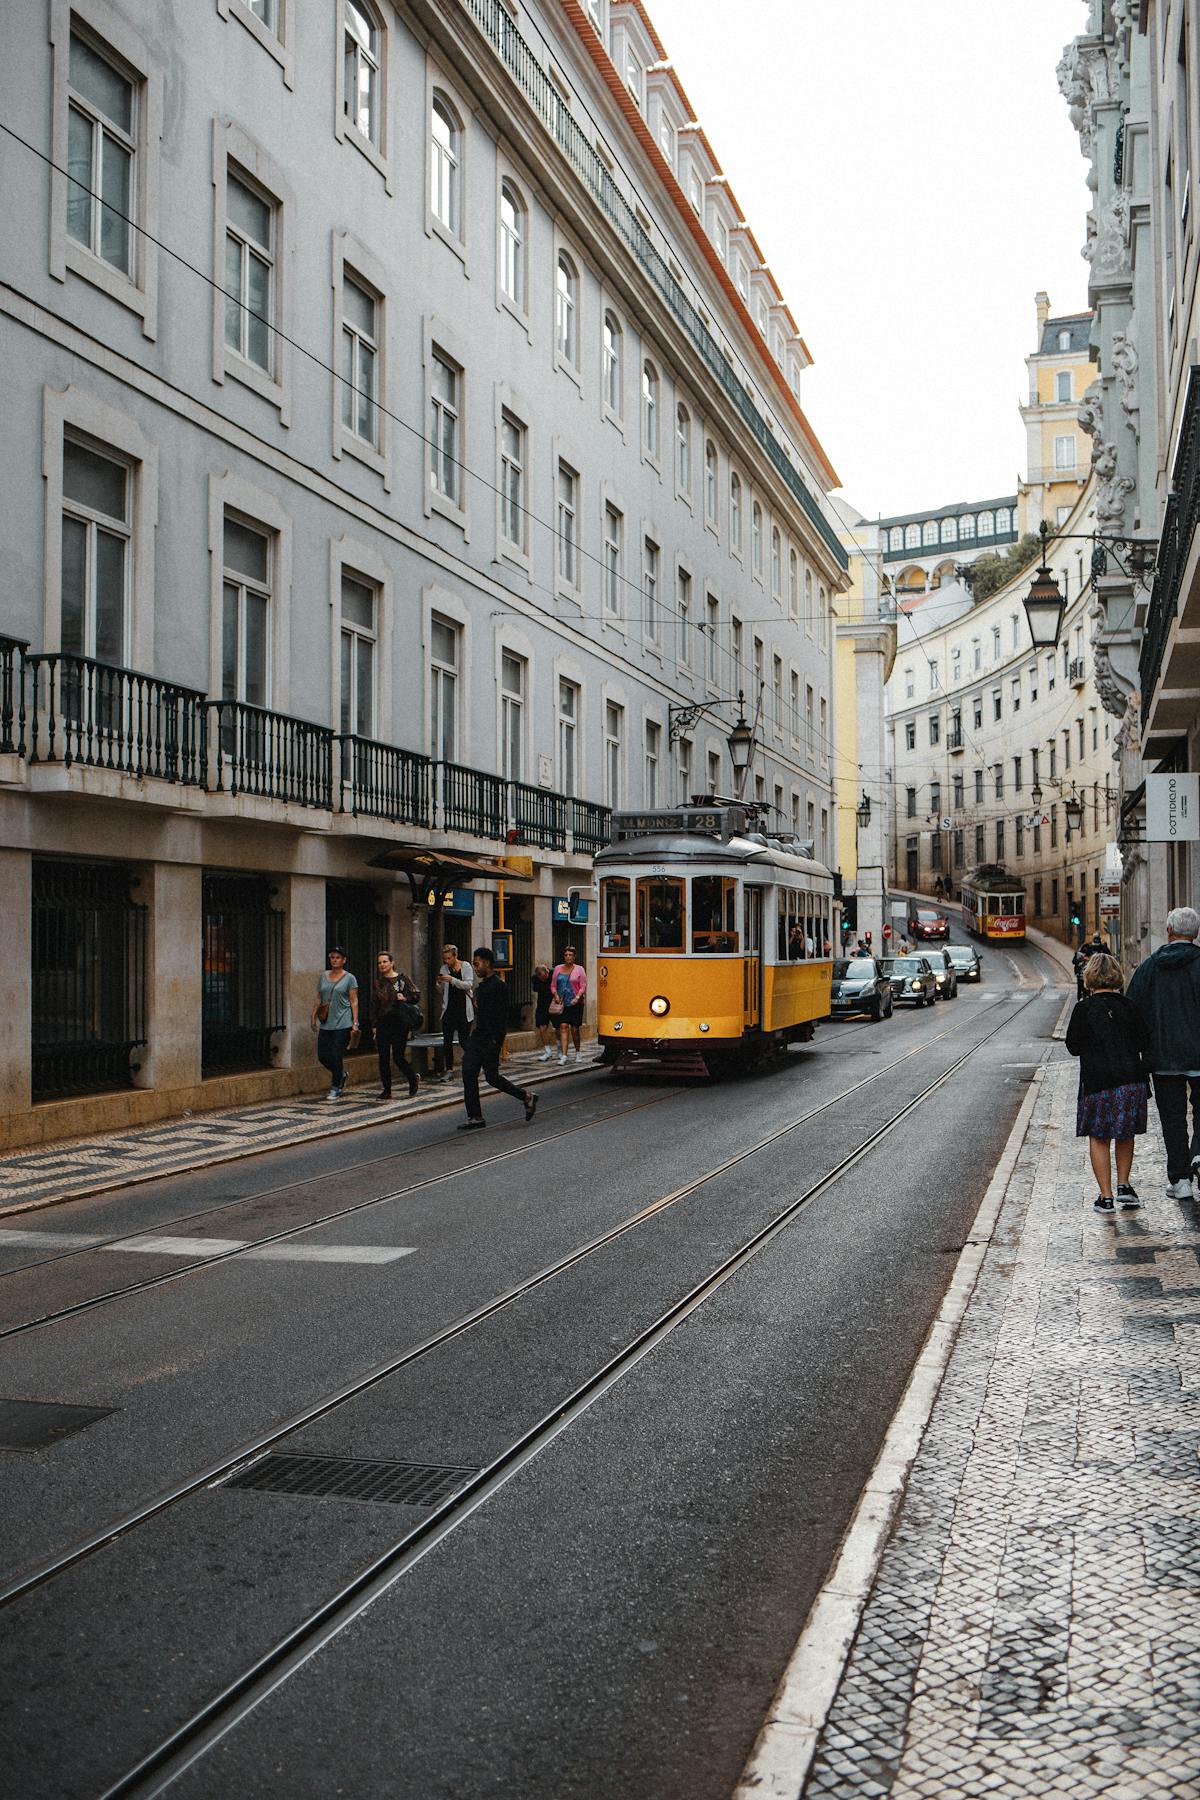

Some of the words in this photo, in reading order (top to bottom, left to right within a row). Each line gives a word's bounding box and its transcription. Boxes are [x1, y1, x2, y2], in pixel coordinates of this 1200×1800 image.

[695, 815, 716, 828] 28
[943, 818, 950, 829] S
[652, 865, 666, 873] 556
